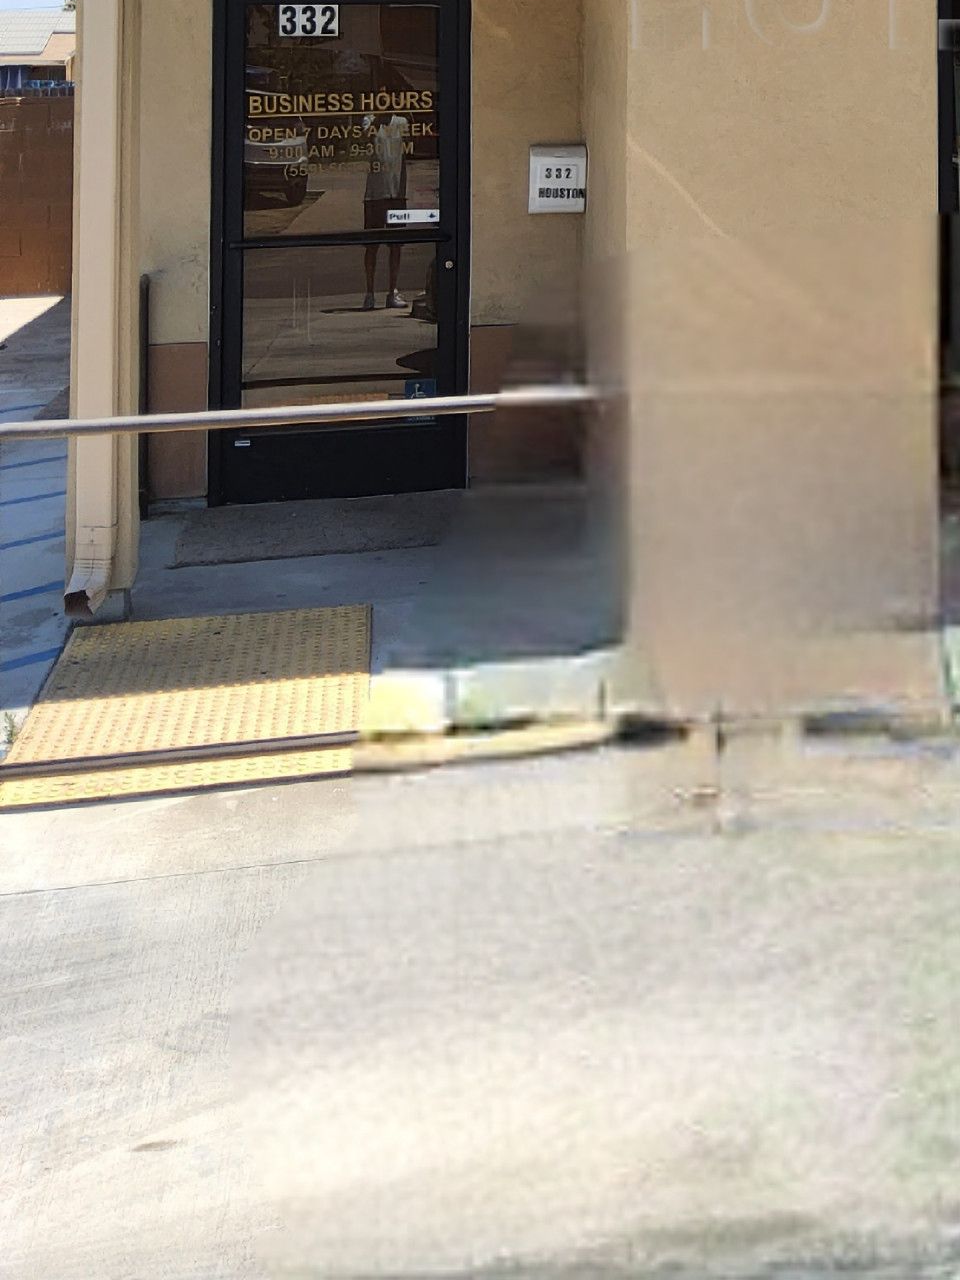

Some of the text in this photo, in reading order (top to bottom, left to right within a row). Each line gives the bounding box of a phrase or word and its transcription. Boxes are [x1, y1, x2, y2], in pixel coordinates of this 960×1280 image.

[281, 5, 336, 35] 332
[249, 91, 433, 114] BUSINESS HOURS
[248, 127, 298, 141] OPEN
[317, 124, 362, 139] DAYS
[379, 122, 433, 138] EEK
[308, 144, 335, 159] AM
[545, 167, 572, 179] 332
[538, 187, 586, 199] HOUSTON
